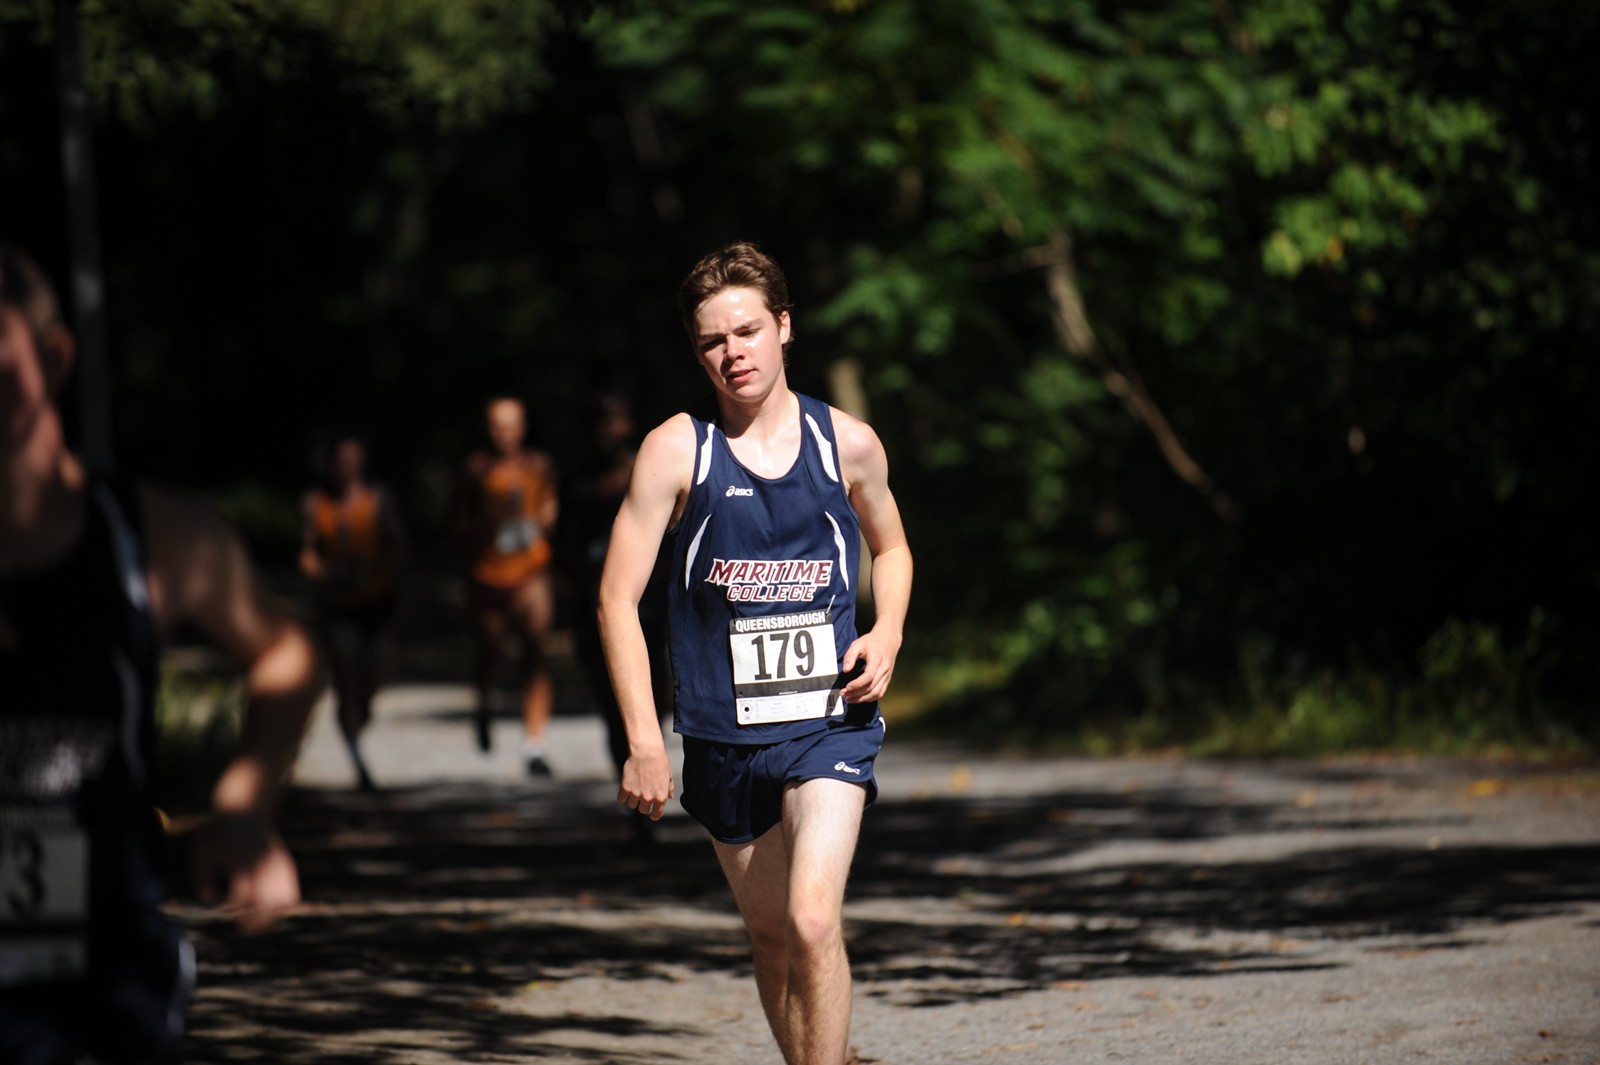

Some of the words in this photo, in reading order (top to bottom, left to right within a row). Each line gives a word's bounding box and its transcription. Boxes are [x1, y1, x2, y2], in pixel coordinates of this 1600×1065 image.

[704, 558, 833, 587] MARITIME
[727, 584, 817, 602] COLLEGE
[735, 611, 826, 633] QUEENSBOROUGH
[751, 629, 815, 681] 179
